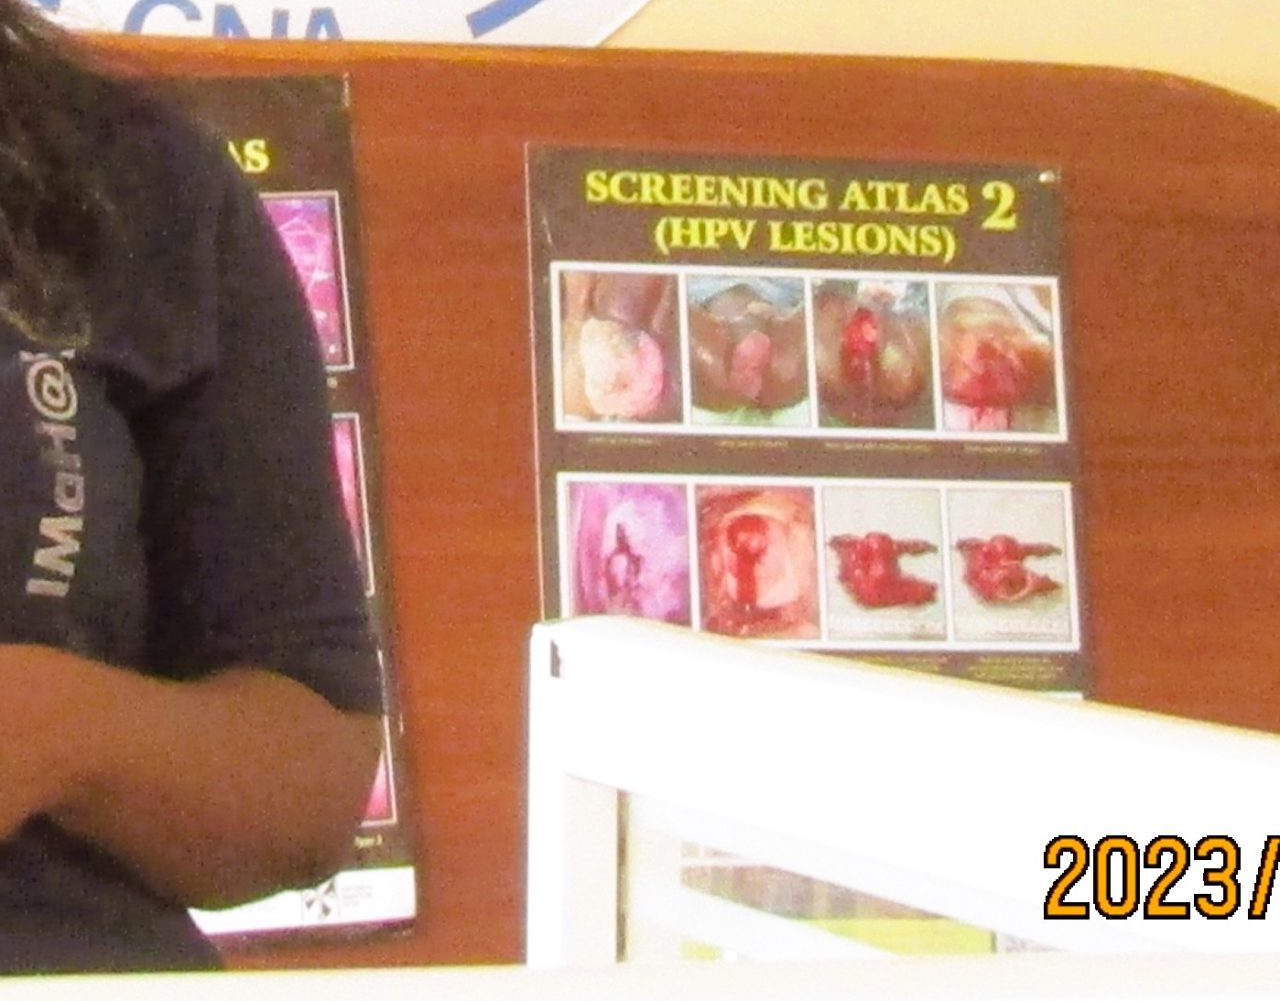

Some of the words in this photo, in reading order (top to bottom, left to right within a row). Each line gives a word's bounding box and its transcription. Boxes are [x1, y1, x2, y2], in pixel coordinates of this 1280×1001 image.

[585, 170, 829, 213] SCREENING
[838, 181, 970, 215] ATLAS
[981, 181, 1017, 230] 2
[654, 216, 756, 255] (HPV
[768, 219, 958, 263] LESIONS)
